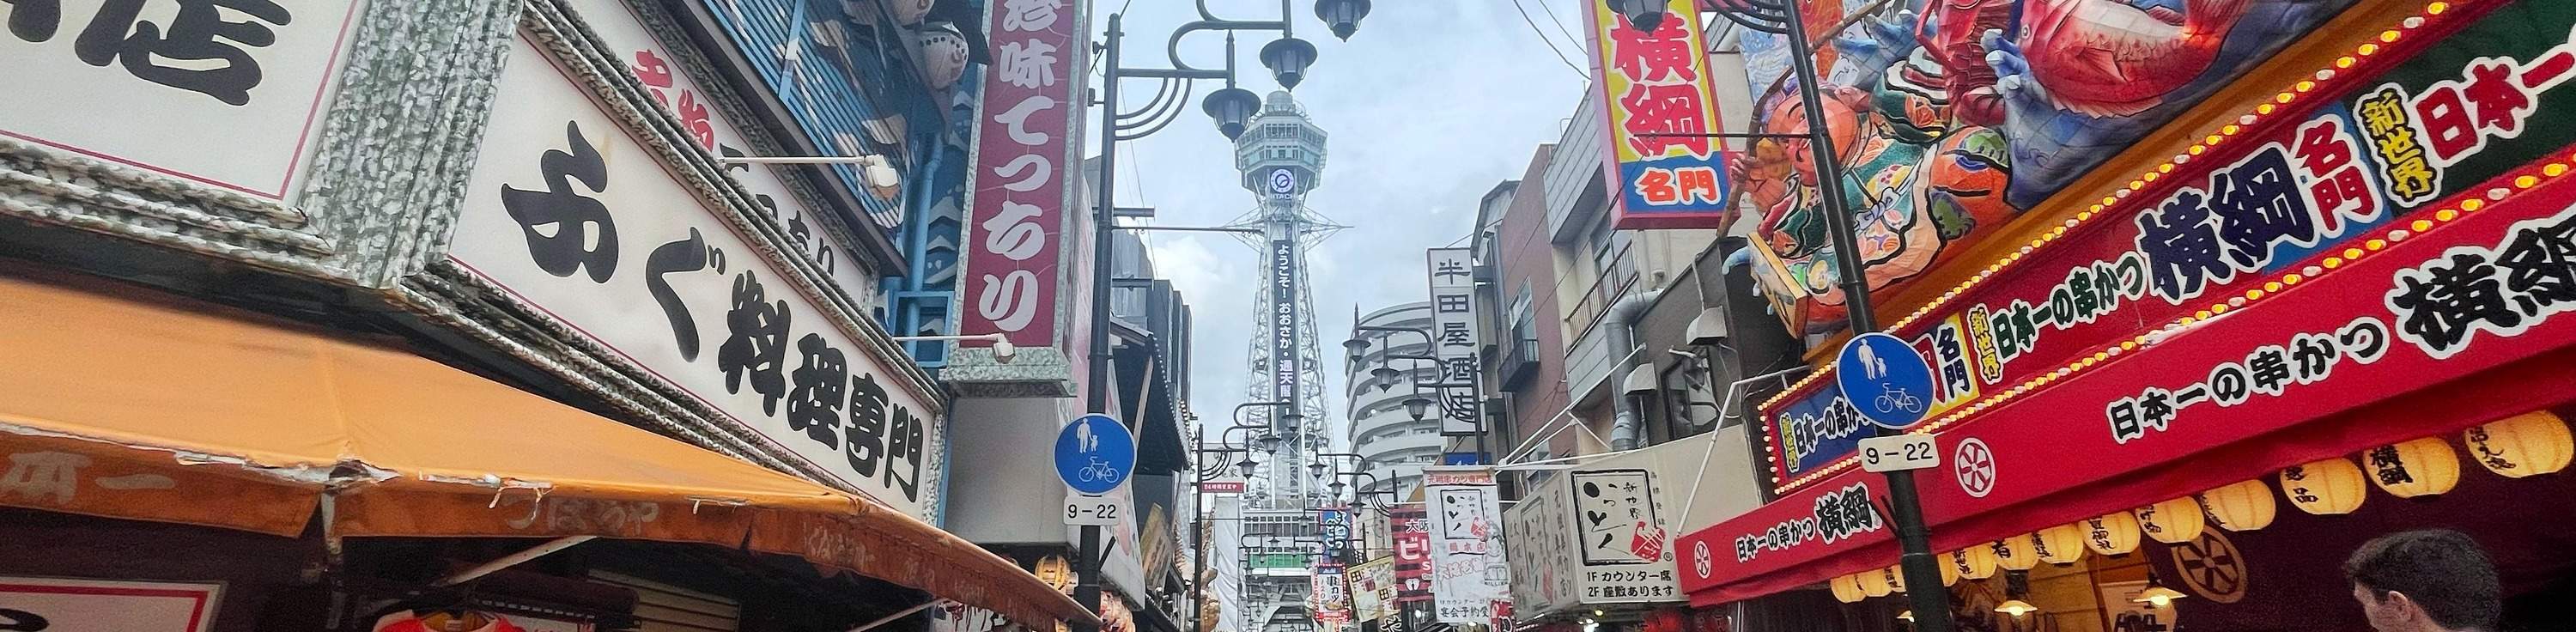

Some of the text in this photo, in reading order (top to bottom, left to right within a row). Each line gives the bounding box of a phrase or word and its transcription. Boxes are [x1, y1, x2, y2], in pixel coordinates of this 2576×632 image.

[8, 0, 292, 106] 店
[1611, 12, 1710, 157] 横綱
[1638, 170, 1717, 202] 名門
[2295, 121, 2375, 231] 名門
[2359, 88, 2437, 202] 新世界
[1993, 147, 2315, 358] 日本一の串かつ 横綱
[501, 119, 925, 503] ふぐ料理専門
[1435, 258, 1476, 420] 半田屋酒店
[1938, 327, 1971, 398] 名門
[1969, 309, 2001, 380] 新世界
[1793, 400, 1870, 455] 日本一の串か
[2110, 322, 2384, 440] 日本一の串かつ
[1866, 441, 1934, 465] 9-22
[1067, 503, 1116, 520] 9-22
[1737, 485, 1874, 558] 日本一の串かつ 横綱
